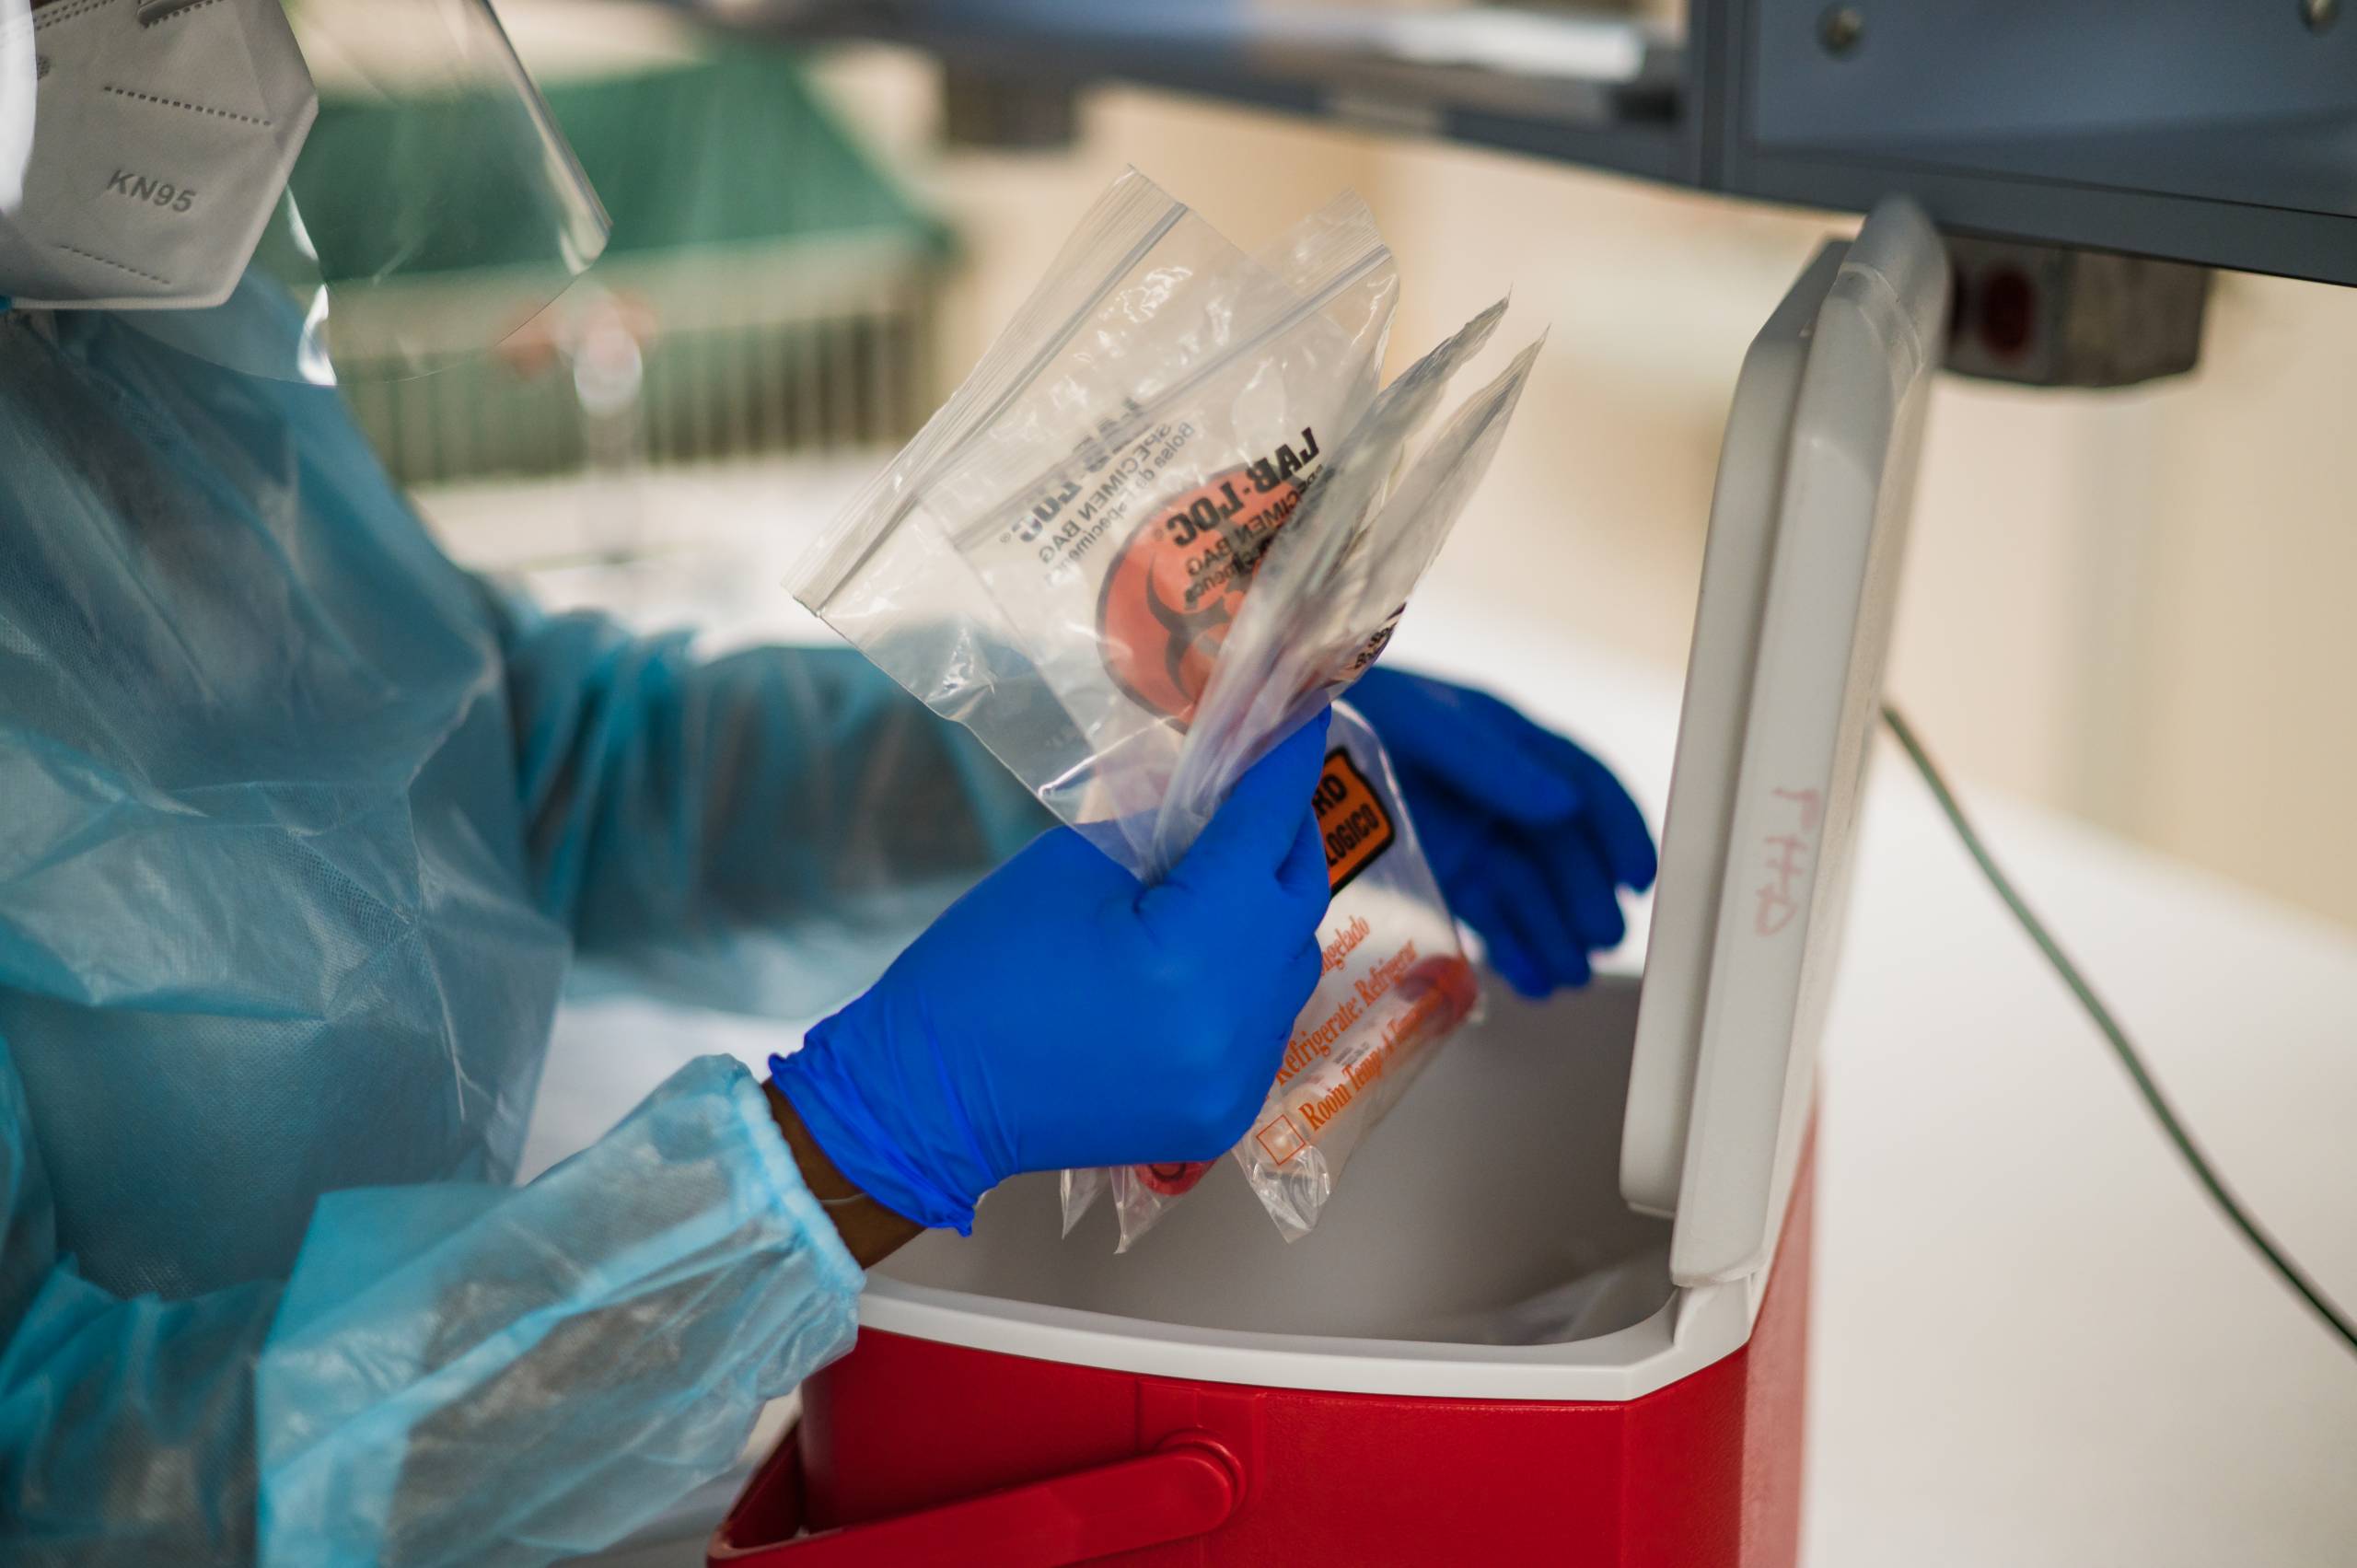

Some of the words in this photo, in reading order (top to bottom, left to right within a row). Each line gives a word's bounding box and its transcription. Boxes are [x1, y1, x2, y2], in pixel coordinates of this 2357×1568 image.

[106, 168, 196, 213] KN95
[1326, 802, 1379, 867] LOGICO
[1321, 915, 1370, 979] ngelado
[1298, 1083, 1353, 1132] Room
